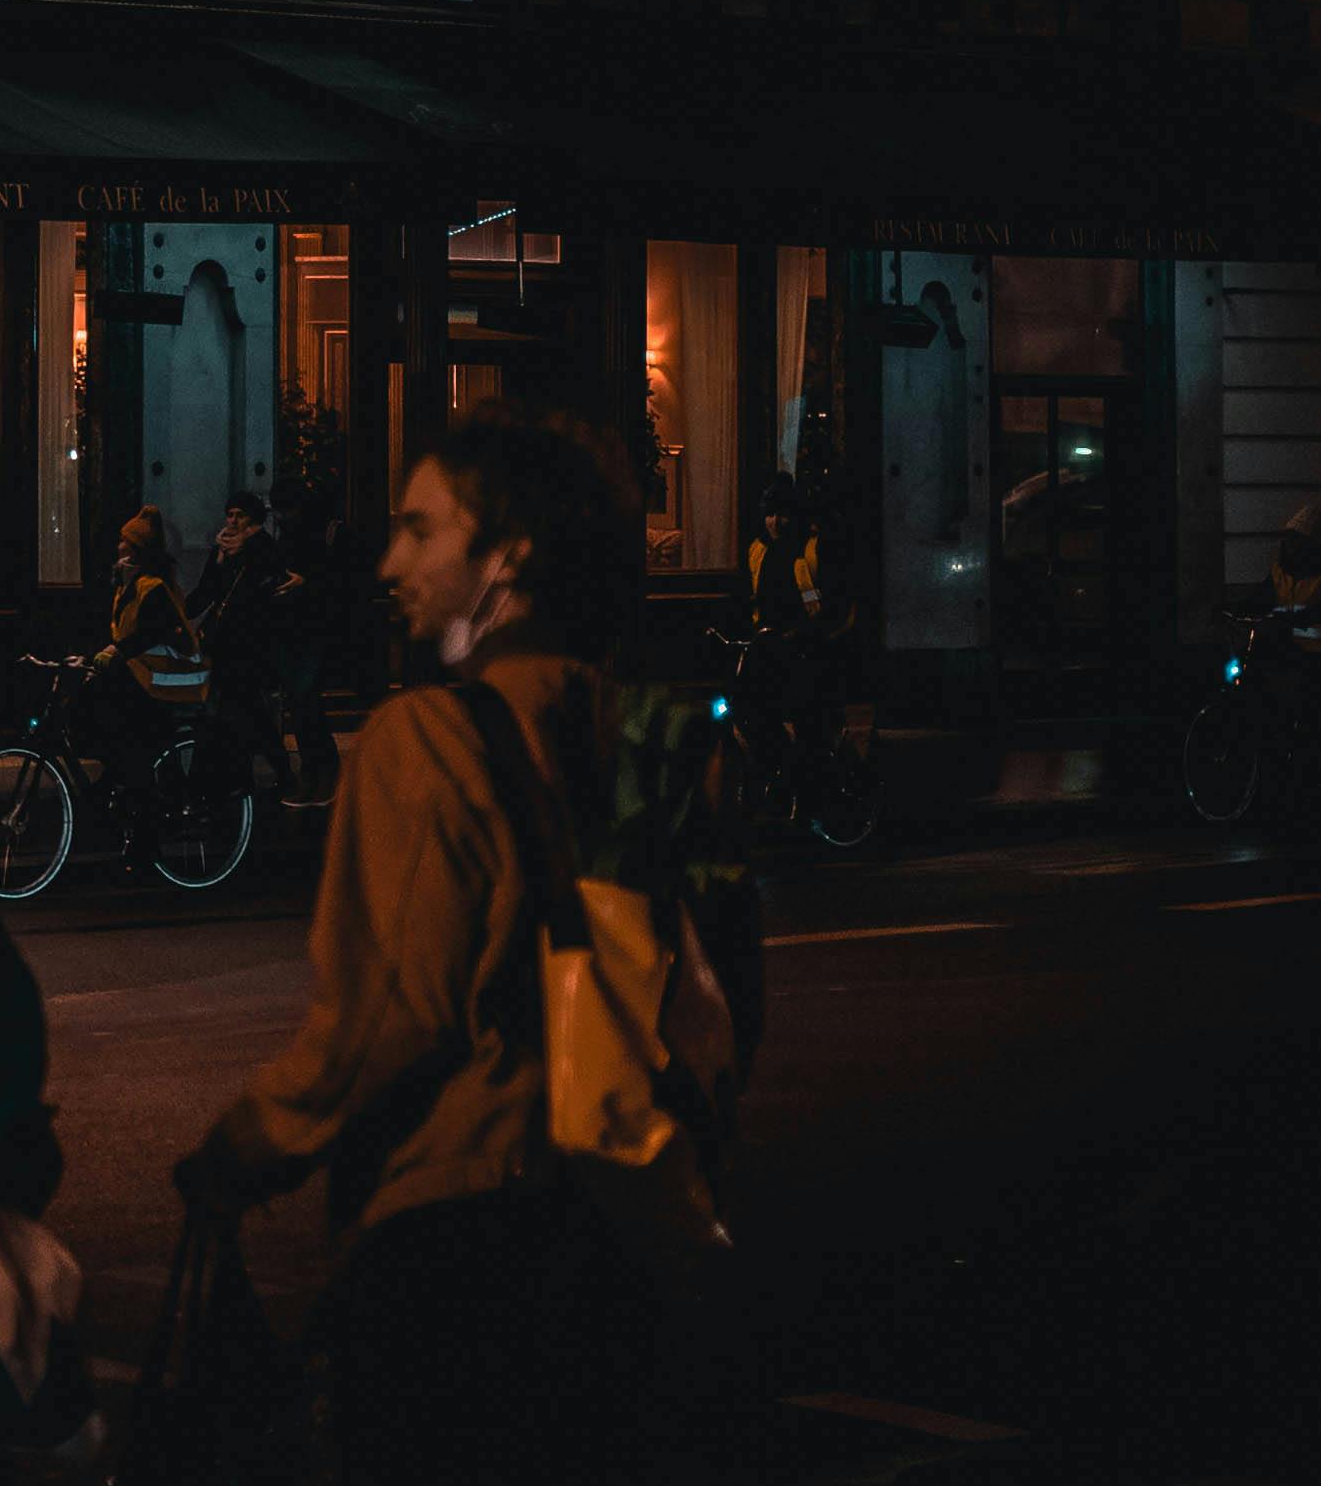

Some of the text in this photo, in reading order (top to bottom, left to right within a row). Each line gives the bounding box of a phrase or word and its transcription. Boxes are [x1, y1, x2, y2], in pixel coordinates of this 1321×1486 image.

[78, 179, 144, 213] CAFÉ
[159, 185, 187, 212] de
[198, 186, 222, 213] la
[233, 188, 294, 214] PAIX
